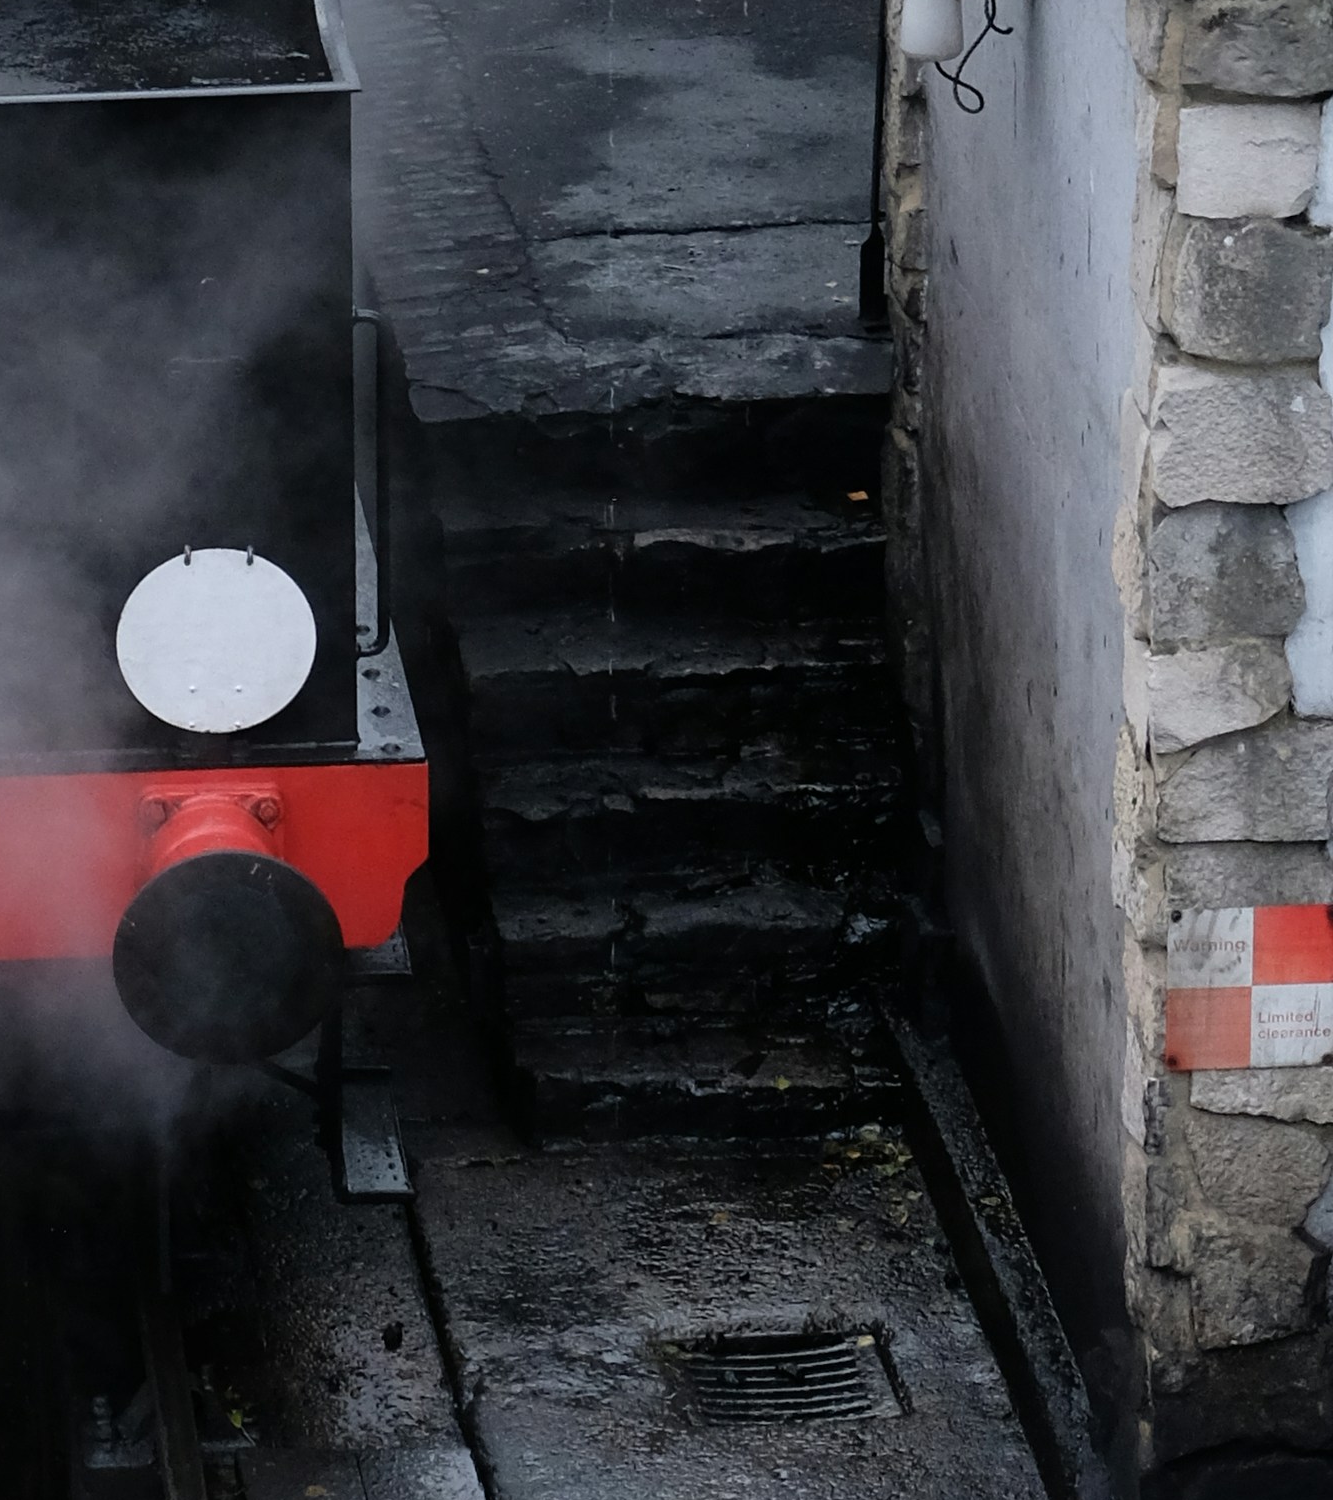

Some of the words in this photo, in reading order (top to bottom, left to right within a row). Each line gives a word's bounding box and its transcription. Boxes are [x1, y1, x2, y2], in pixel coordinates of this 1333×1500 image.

[1173, 938, 1246, 953] Warning
[1258, 1011, 1314, 1024] Limited
[1258, 1028, 1332, 1040] clearance
